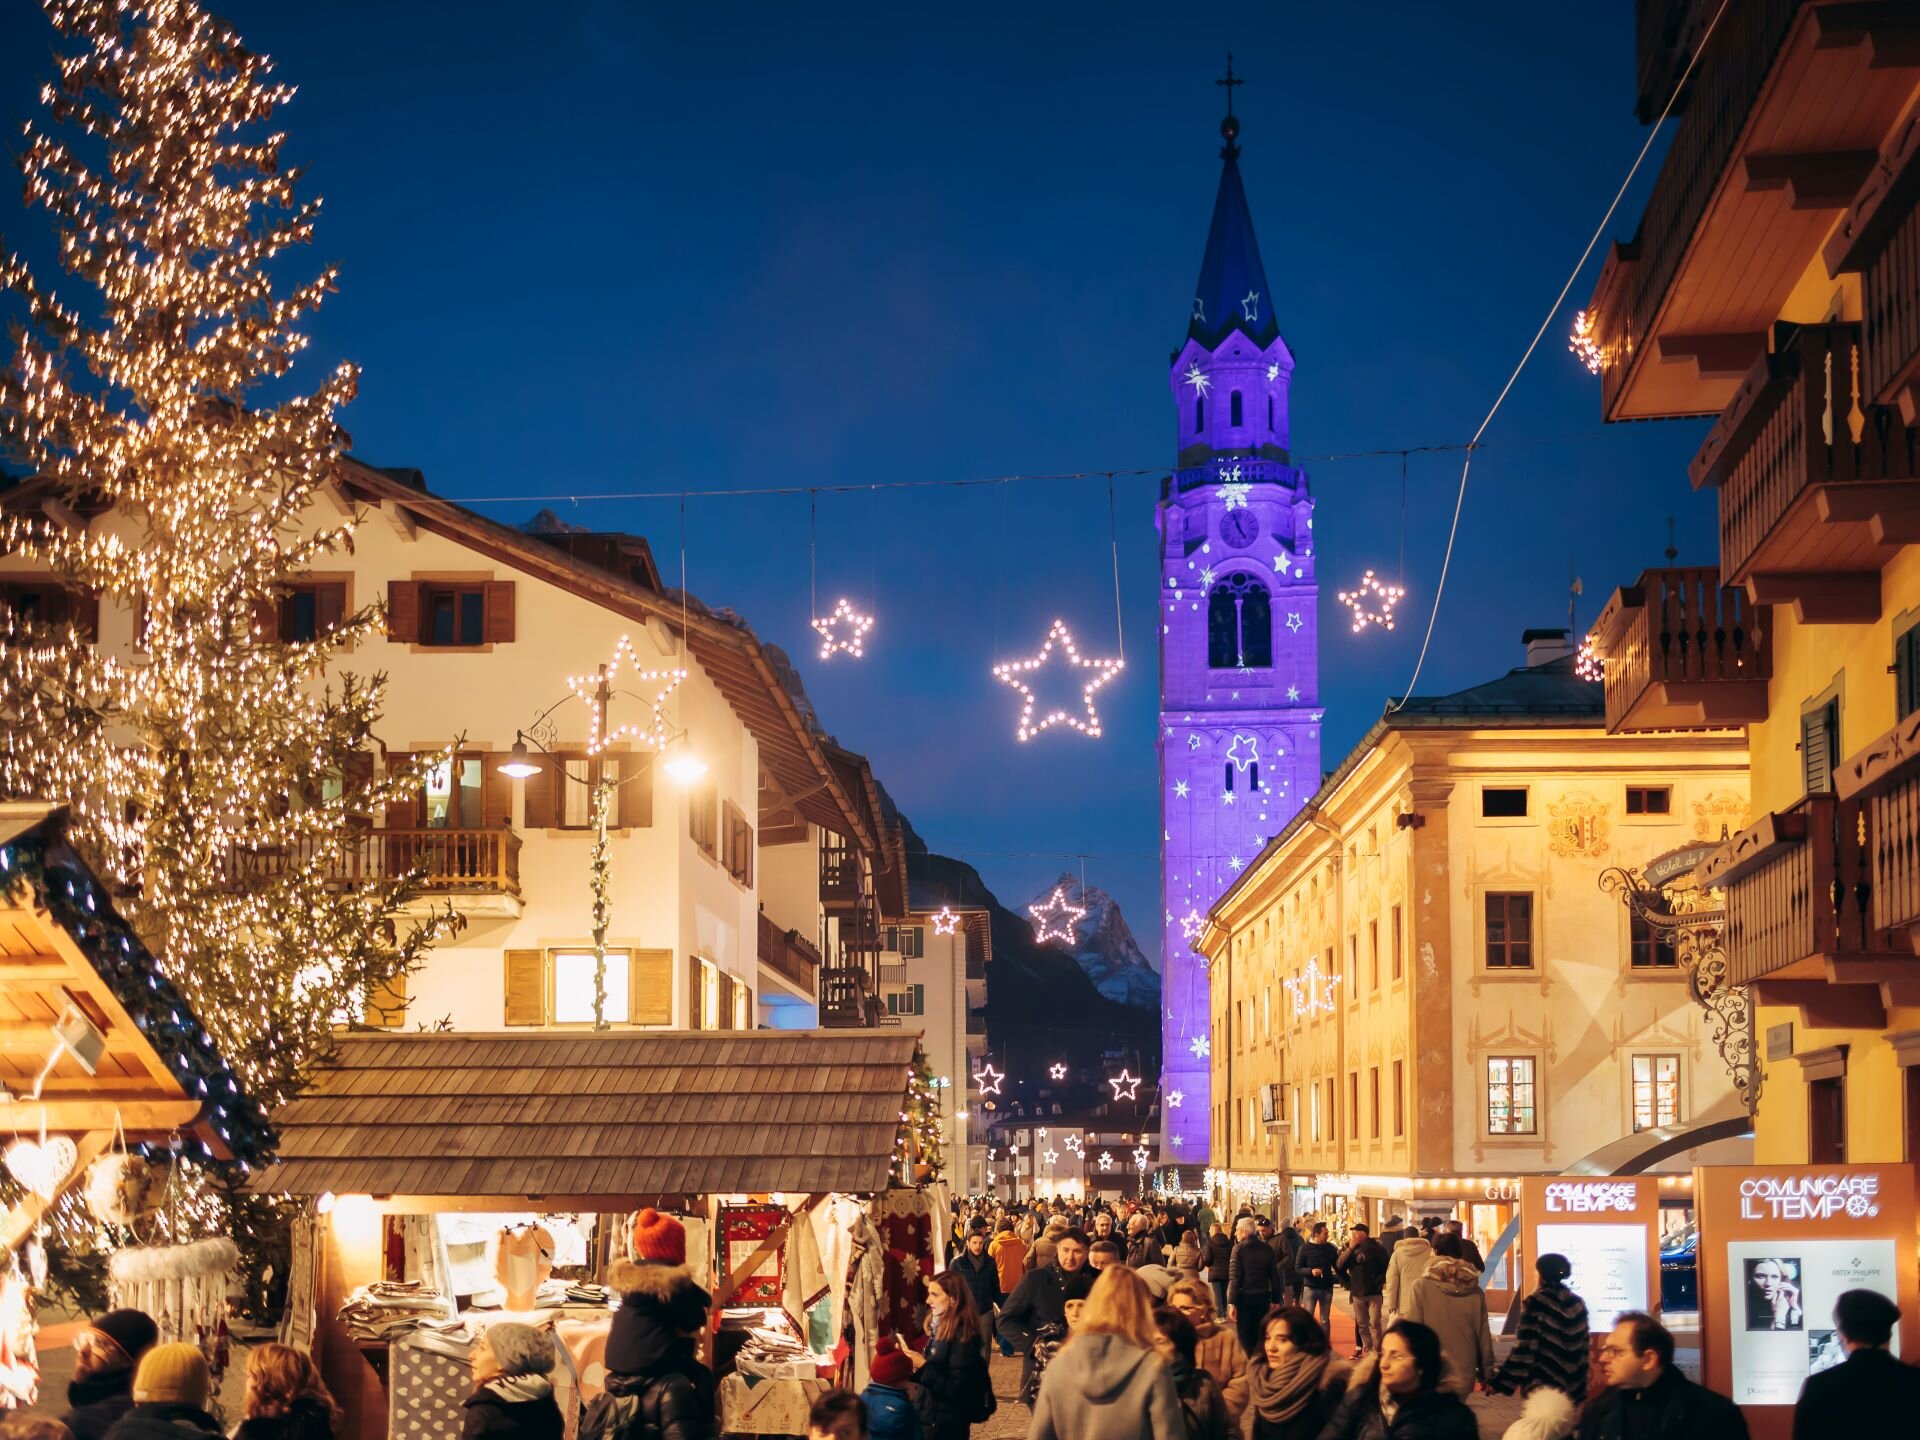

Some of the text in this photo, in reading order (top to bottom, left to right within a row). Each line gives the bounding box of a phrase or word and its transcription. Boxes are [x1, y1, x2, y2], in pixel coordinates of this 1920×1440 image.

[1739, 1177, 1879, 1197] COMUNICARE
[1741, 1196, 1764, 1219] IL
[1832, 1269, 1881, 1277] PATEK PHILIPPE
